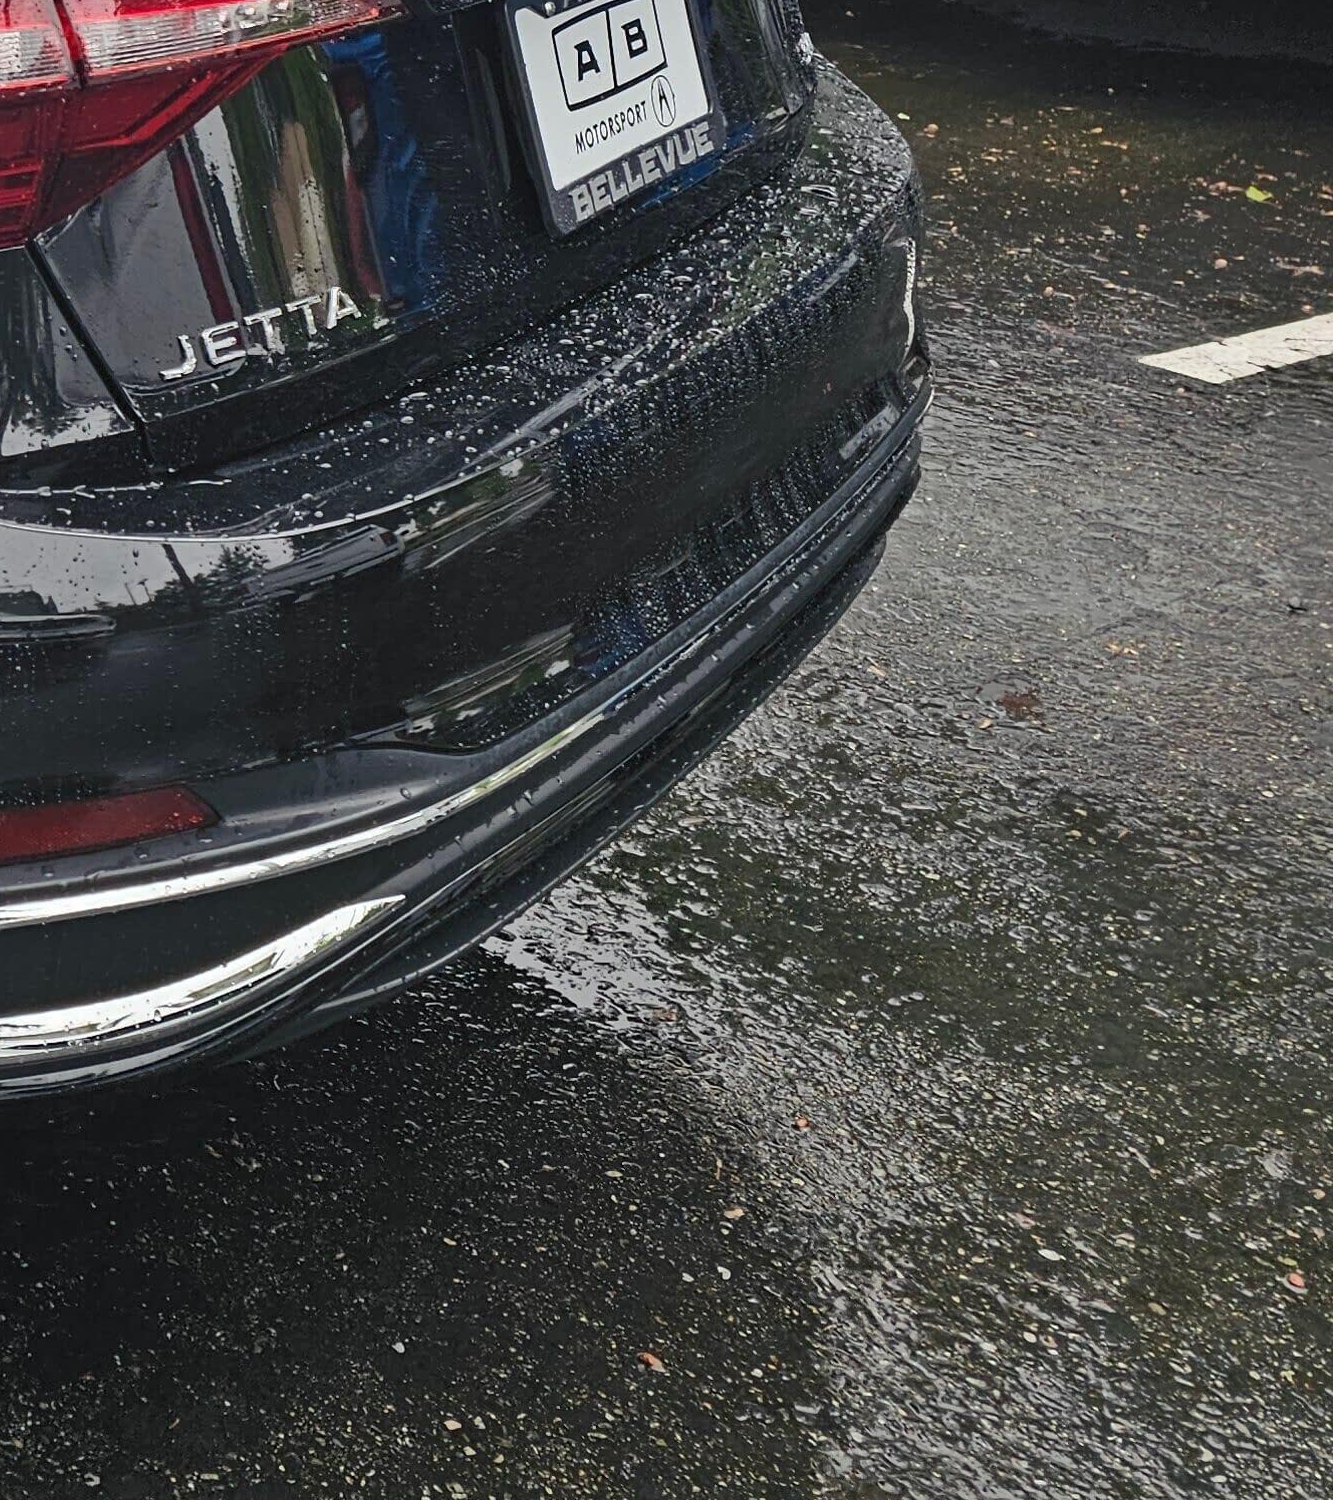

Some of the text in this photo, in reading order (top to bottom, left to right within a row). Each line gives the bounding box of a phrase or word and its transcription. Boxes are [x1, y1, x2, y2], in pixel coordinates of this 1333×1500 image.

[574, 18, 648, 82] A B
[575, 100, 647, 155] MOTORSPORT
[567, 121, 715, 223] BELLEVUE
[159, 286, 362, 381] JETTA
